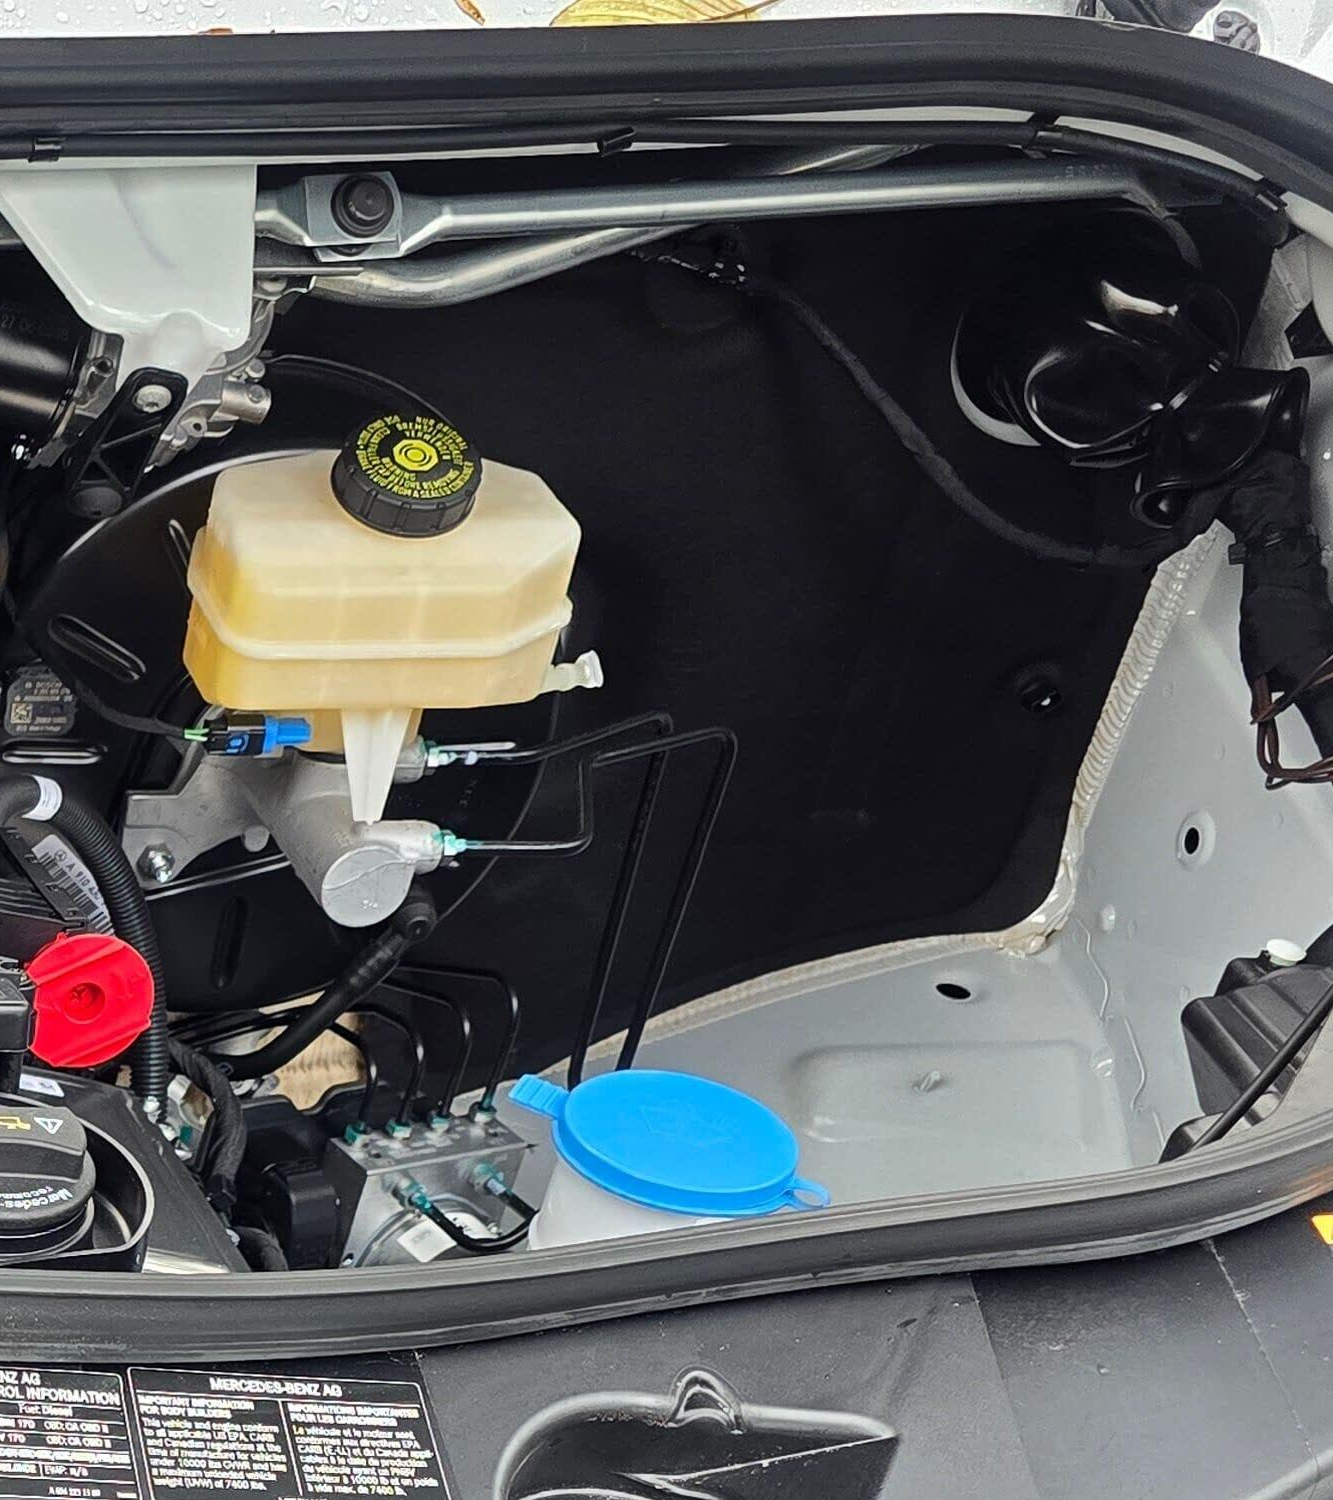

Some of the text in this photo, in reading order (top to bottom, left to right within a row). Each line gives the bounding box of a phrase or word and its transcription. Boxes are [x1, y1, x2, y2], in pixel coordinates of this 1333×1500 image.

[21, 1372, 41, 1386] AG
[209, 1377, 342, 1397] MERCEDES-BENZ AG
[26, 1386, 121, 1405] INFORMATION
[137, 1395, 254, 1410] IMPORTANT INFORMATION
[44, 1404, 73, 1417] Diesel
[139, 1404, 232, 1418] FOR BODY BUILDERS
[18, 1419, 36, 1429] 170
[141, 1417, 160, 1427] This
[162, 1418, 192, 1429] vehicle
[194, 1420, 210, 1430] and
[212, 1421, 241, 1433] engine
[290, 1413, 317, 1423] POUR
[318, 1414, 334, 1424] LES
[7, 1432, 26, 1443] 170
[143, 1427, 154, 1437] to
[168, 1429, 211, 1441] applicable
[213, 1430, 226, 1440] US
[250, 1432, 275, 1443] CARB
[292, 1425, 305, 1435] Le
[342, 1427, 352, 1437] et
[362, 1429, 393, 1439] moteur
[146, 1438, 163, 1447] and
[164, 1439, 205, 1450] Canadian
[207, 1441, 254, 1452] regulations
[265, 1443, 282, 1453] the
[295, 1436, 421, 1450] conformes aux directives EPA
[147, 1448, 287, 1463] time of manufacture for vehicles
[352, 1447, 362, 1457] et
[363, 1447, 375, 1457] du
[376, 1448, 410, 1459] Canada
[149, 1457, 175, 1467] under
[178, 1458, 206, 1468] 10000
[223, 1460, 250, 1471] GVWR
[252, 1462, 269, 1472] and
[347, 1457, 367, 1467] date
[368, 1458, 380, 1467] de
[381, 1458, 428, 1470] production
[160, 1468, 202, 1479] maximum
[203, 1470, 245, 1480] unloaded
[246, 1471, 277, 1482] vehicle
[351, 1475, 378, 1486] 10000
[390, 1477, 400, 1487] et
[414, 1478, 439, 1488] poids
[153, 1477, 183, 1489] weight
[184, 1478, 213, 1490] (UVW)
[214, 1479, 224, 1489] of
[224, 1480, 249, 1490] 7400
[314, 1483, 333, 1493] vide
[369, 1485, 394, 1495] 7400
